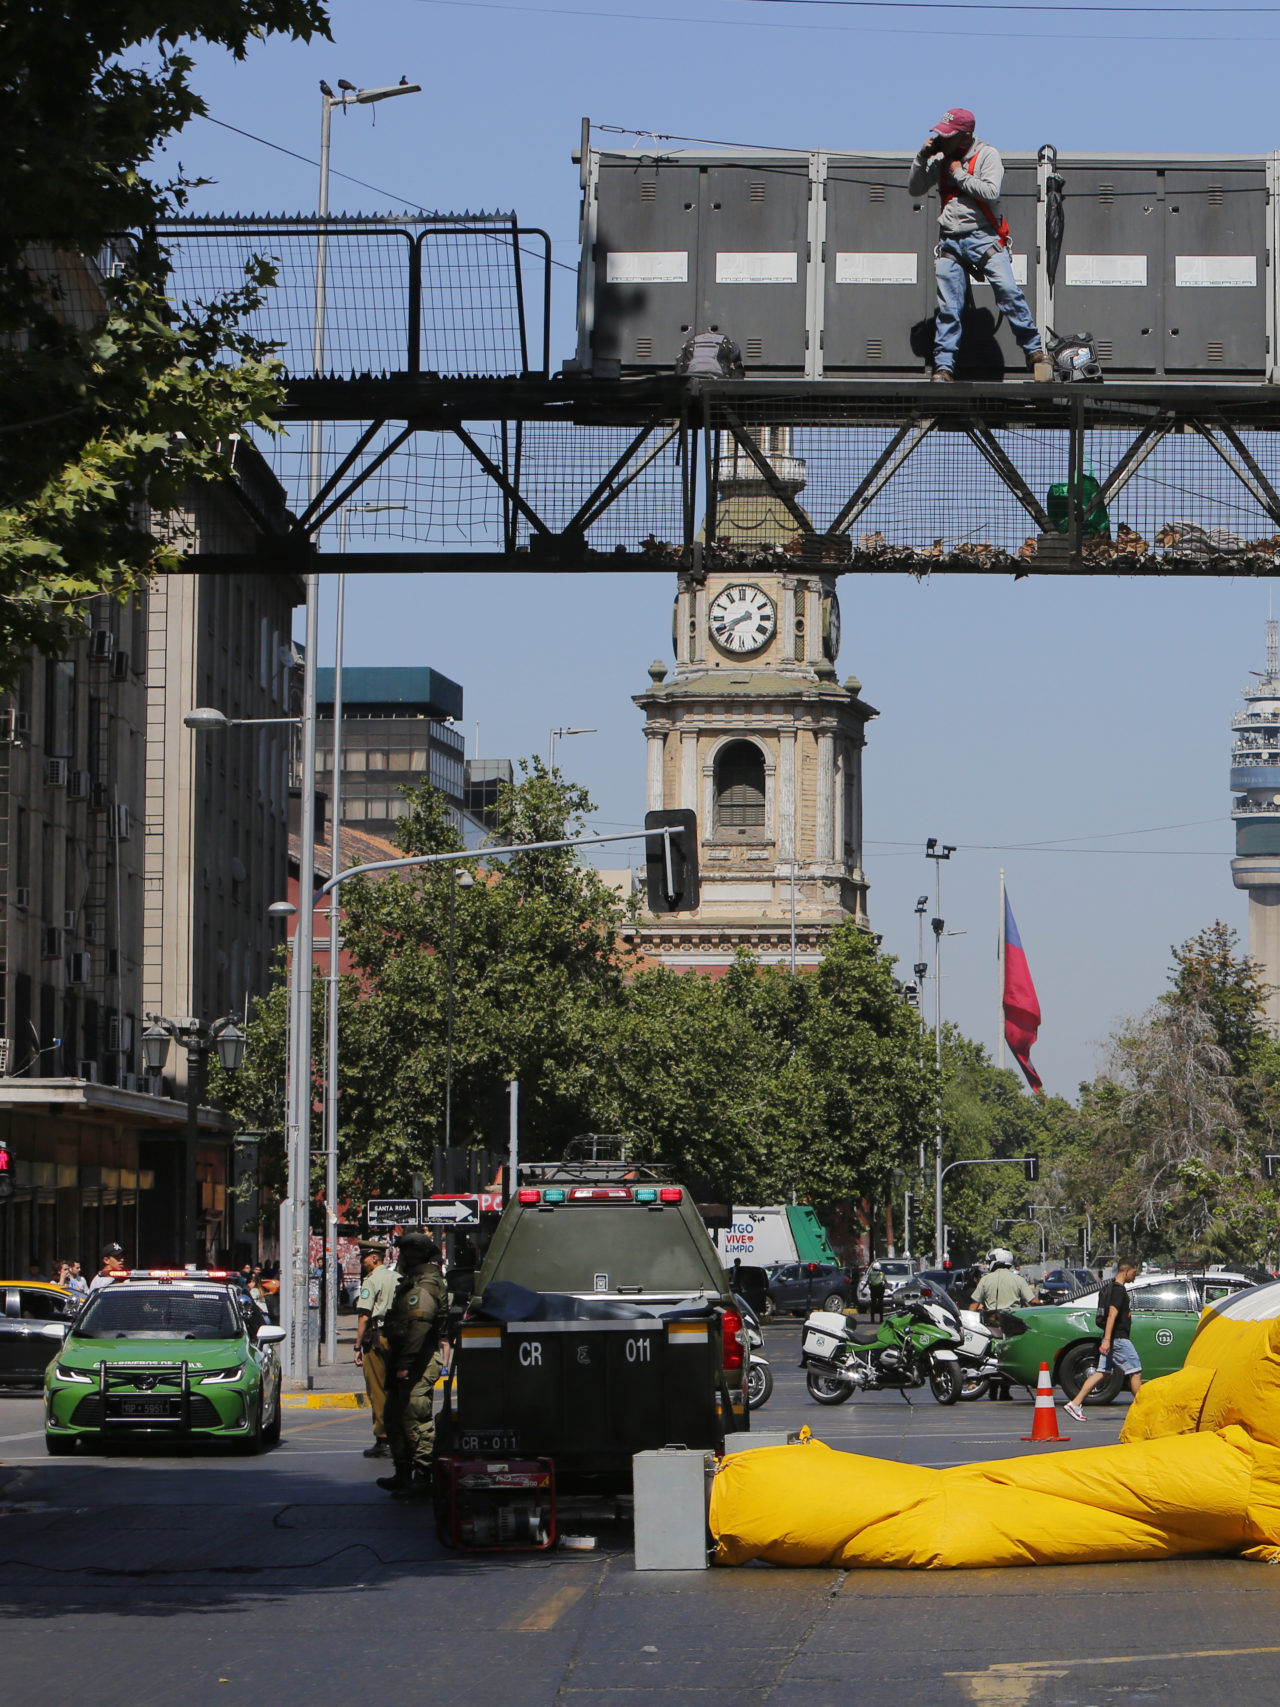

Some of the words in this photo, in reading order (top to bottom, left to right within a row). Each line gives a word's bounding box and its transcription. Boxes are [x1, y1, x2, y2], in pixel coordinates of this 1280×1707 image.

[725, 1234, 747, 1244] VIVE
[519, 1342, 543, 1367] CR
[625, 1338, 651, 1363] 011
[462, 1436, 479, 1450] CR
[492, 1436, 516, 1449] 011
